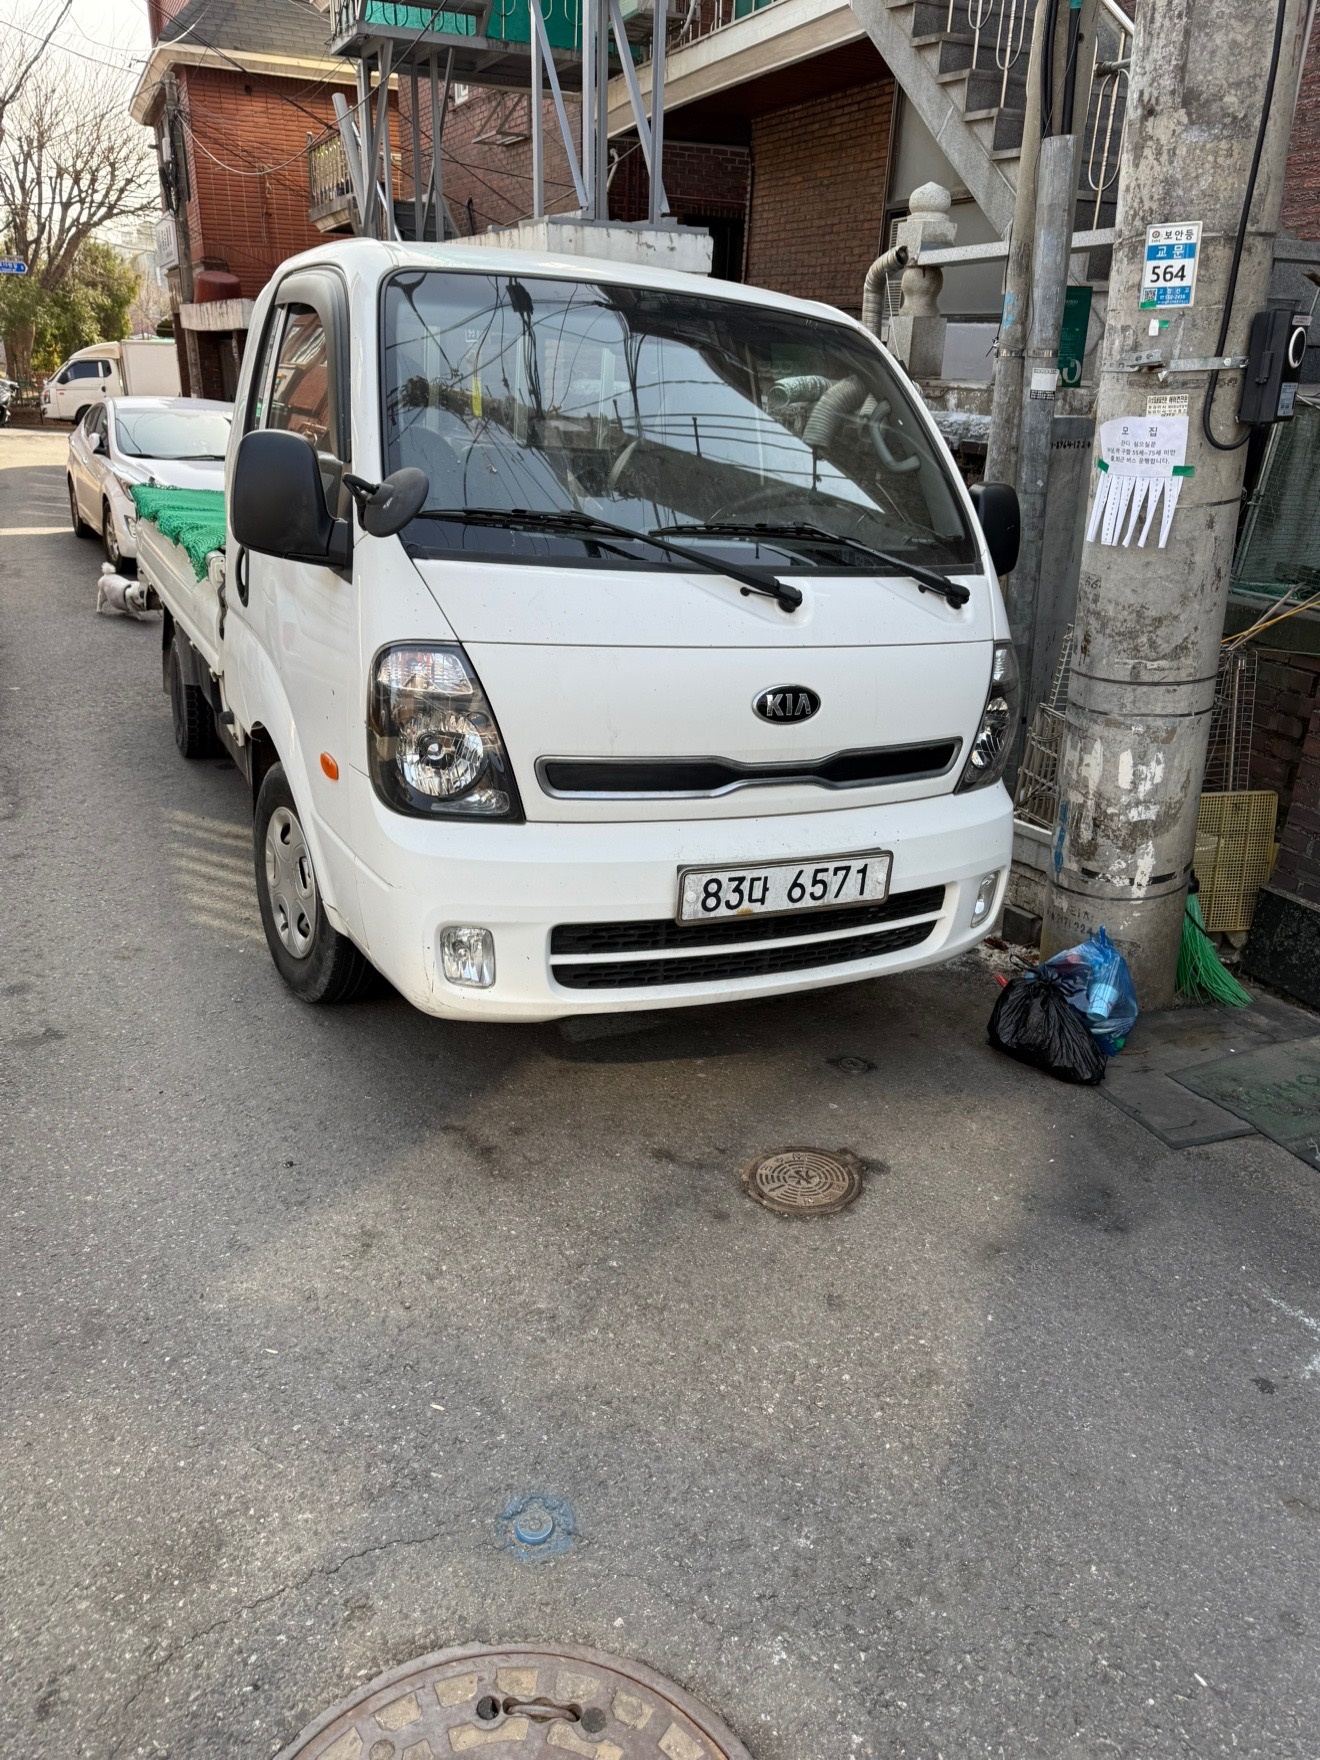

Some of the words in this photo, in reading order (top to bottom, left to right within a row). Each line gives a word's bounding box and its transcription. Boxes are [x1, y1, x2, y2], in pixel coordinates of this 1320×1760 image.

[1164, 229, 1194, 241] 보안등
[1150, 265, 1186, 283] 564
[766, 693, 811, 716] KIA
[701, 876, 769, 912] 83다
[787, 863, 868, 903] 6571
